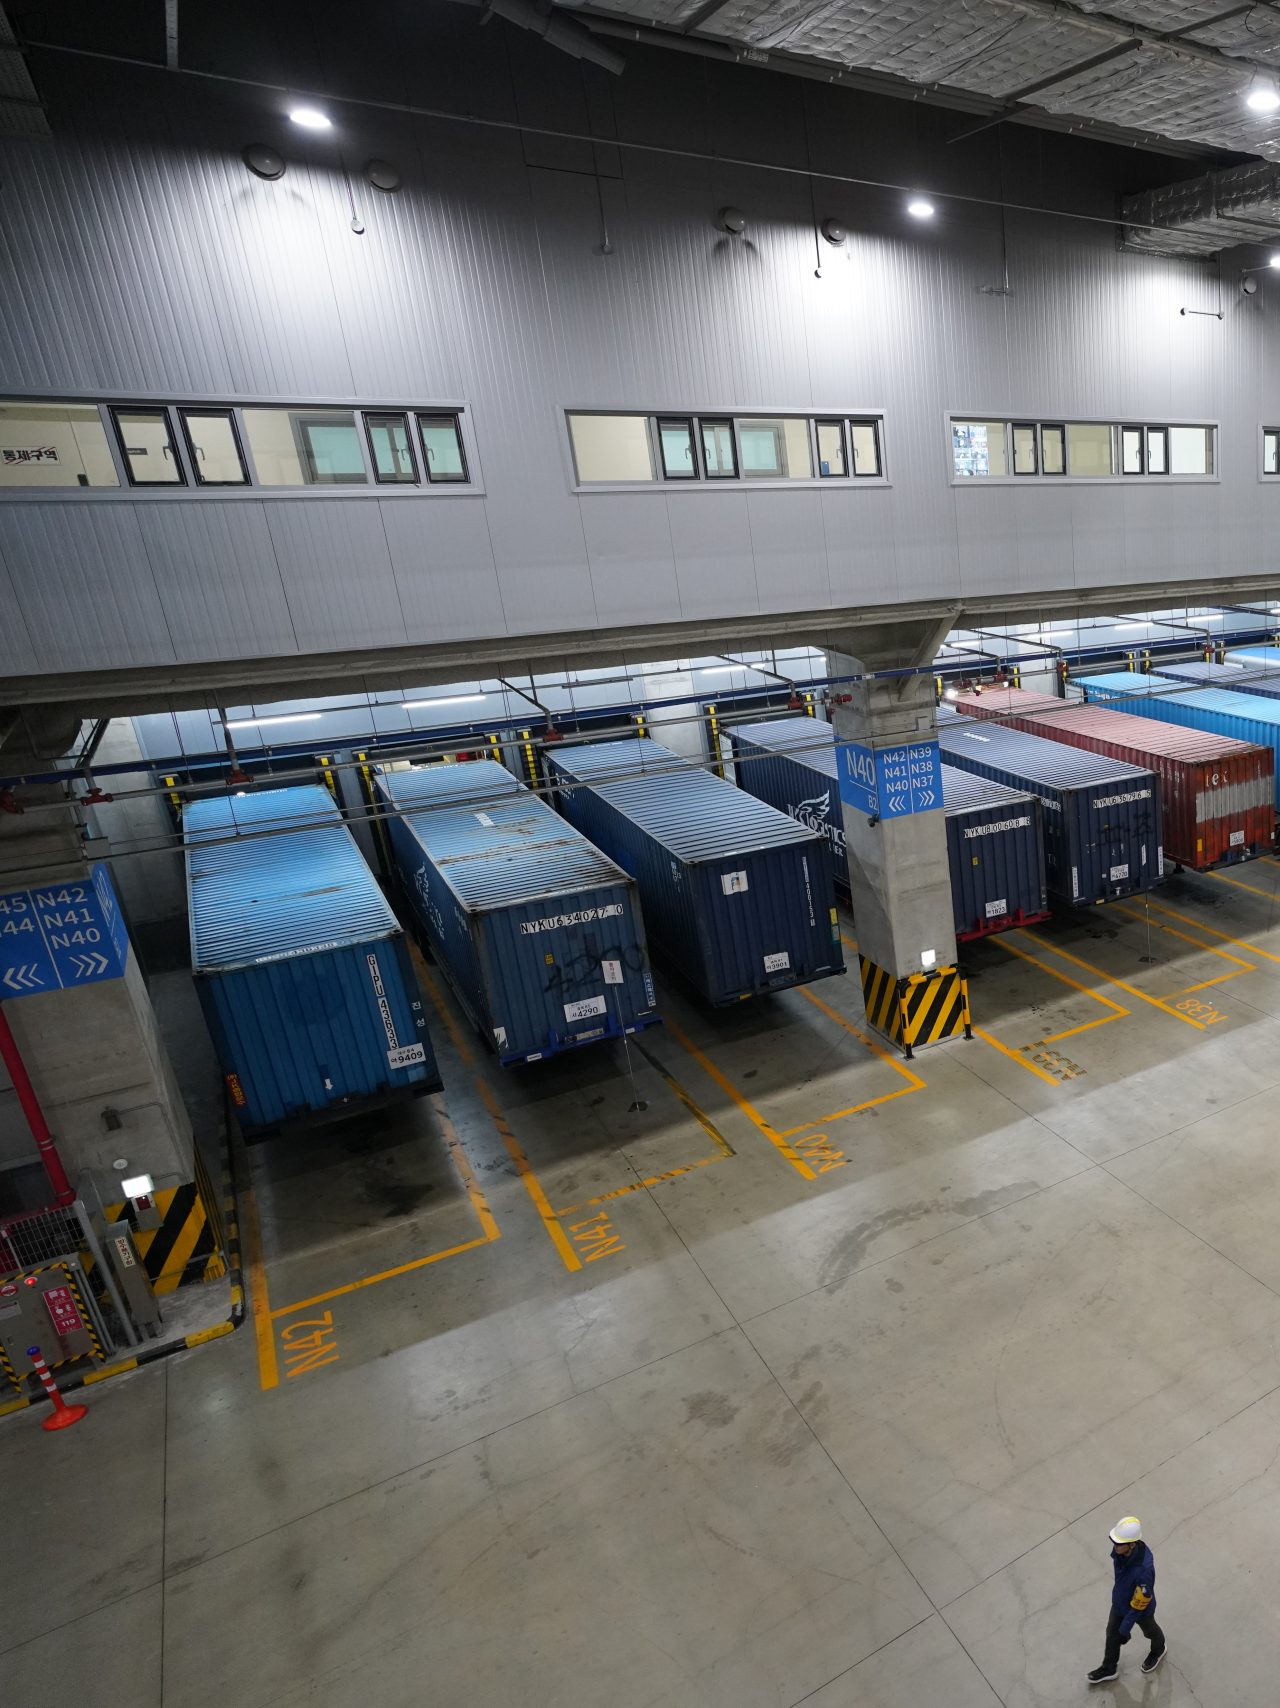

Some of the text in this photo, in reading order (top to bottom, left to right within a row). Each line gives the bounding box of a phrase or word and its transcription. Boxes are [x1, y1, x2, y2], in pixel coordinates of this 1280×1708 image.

[3, 449, 58, 462] 통제구역
[883, 751, 907, 764] N42
[910, 747, 932, 759] N39
[846, 748, 876, 786] N40
[884, 767, 907, 779] N41
[911, 761, 933, 774] N38
[886, 780, 909, 793] N40
[912, 775, 934, 788] N37
[868, 794, 877, 810] B2
[0, 896, 28, 914] 45
[36, 887, 88, 908] N42
[0, 917, 35, 938] 44
[43, 907, 95, 928] N41
[520, 905, 623, 933] NYKU634027 0
[51, 927, 101, 949] N40
[367, 955, 398, 1050] GIPU 43633
[1174, 999, 1229, 1025] N38
[795, 1133, 846, 1174] N40
[568, 1211, 627, 1262] N41
[281, 1311, 340, 1377] N42
